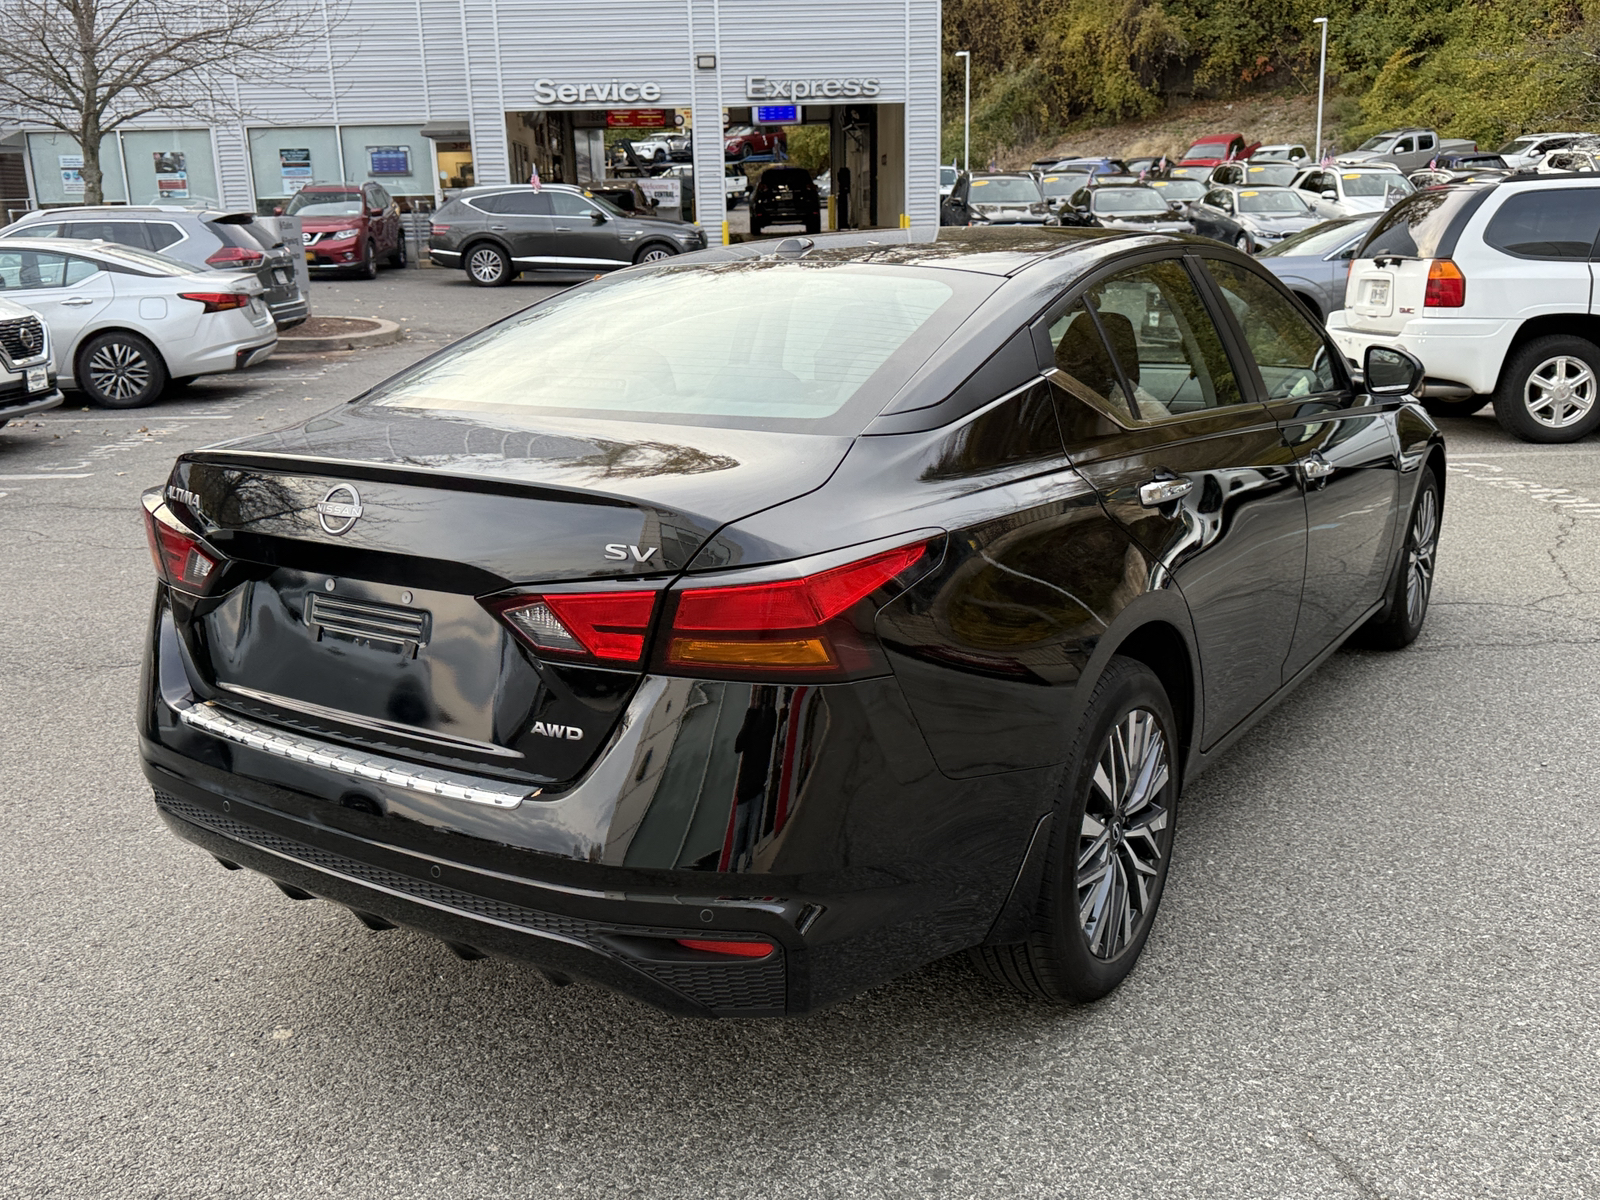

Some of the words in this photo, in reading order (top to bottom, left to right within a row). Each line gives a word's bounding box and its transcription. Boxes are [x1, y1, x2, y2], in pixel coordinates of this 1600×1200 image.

[534, 78, 661, 104] Service
[746, 75, 881, 103] Express
[317, 503, 361, 517] NISSAN
[604, 543, 658, 562] SV
[530, 721, 584, 741] AWD
